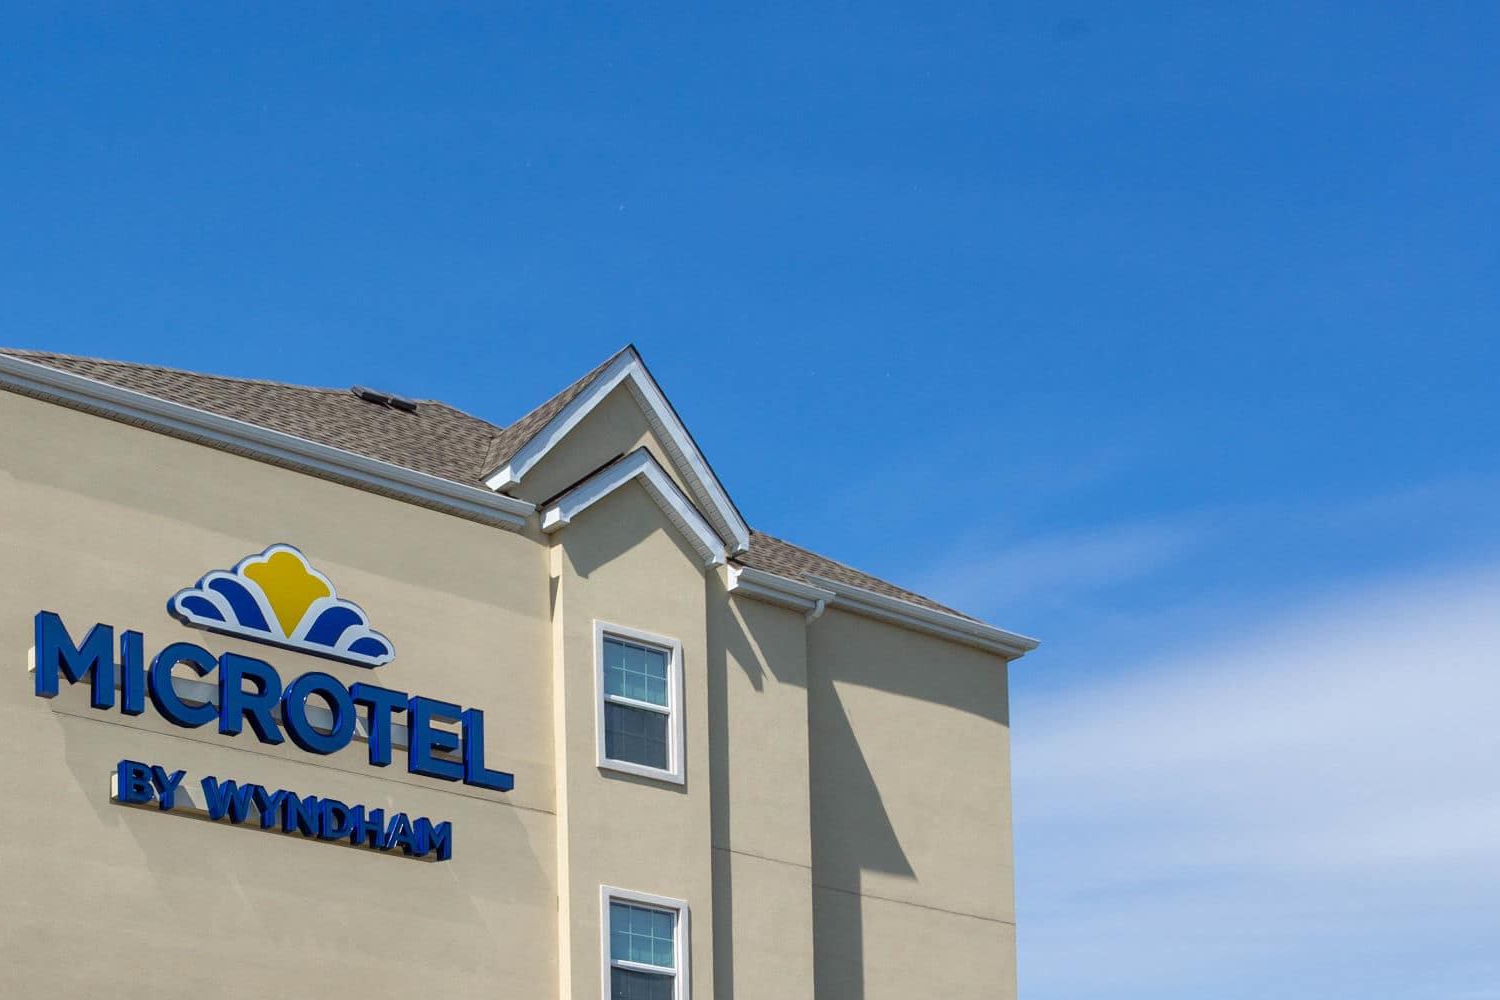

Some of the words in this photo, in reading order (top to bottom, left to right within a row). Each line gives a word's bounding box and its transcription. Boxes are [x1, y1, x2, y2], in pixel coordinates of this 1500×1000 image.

[34, 610, 515, 792] MICROTEL
[117, 760, 186, 811] BY
[201, 776, 453, 861] WYNDHAM
